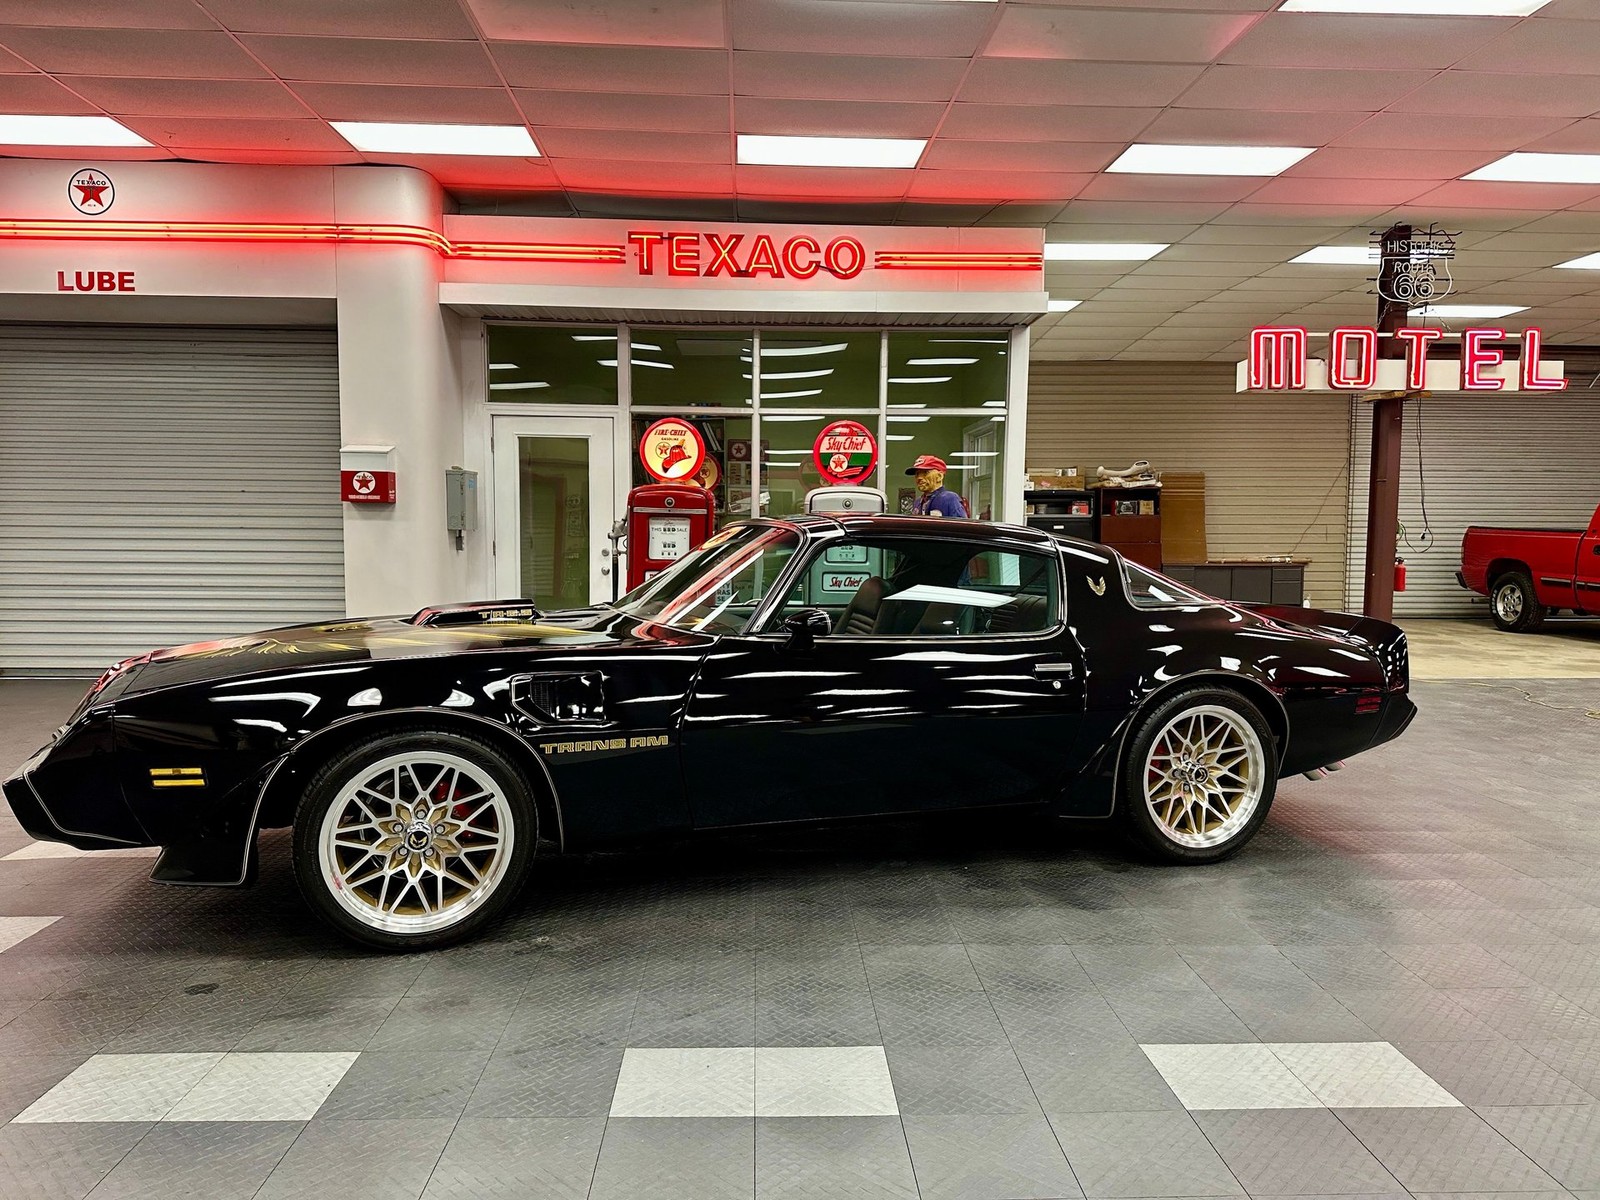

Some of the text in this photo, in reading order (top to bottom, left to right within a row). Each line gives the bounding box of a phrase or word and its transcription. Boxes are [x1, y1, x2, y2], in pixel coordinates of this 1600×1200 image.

[628, 231, 866, 280] TEXACO
[1394, 261, 1435, 274] ROUTE
[57, 271, 135, 291] LUBE
[1393, 272, 1435, 299] 66
[1247, 325, 1569, 391] MOTEL
[826, 437, 867, 452] Sky Chief
[539, 735, 669, 754] TRANS AM
